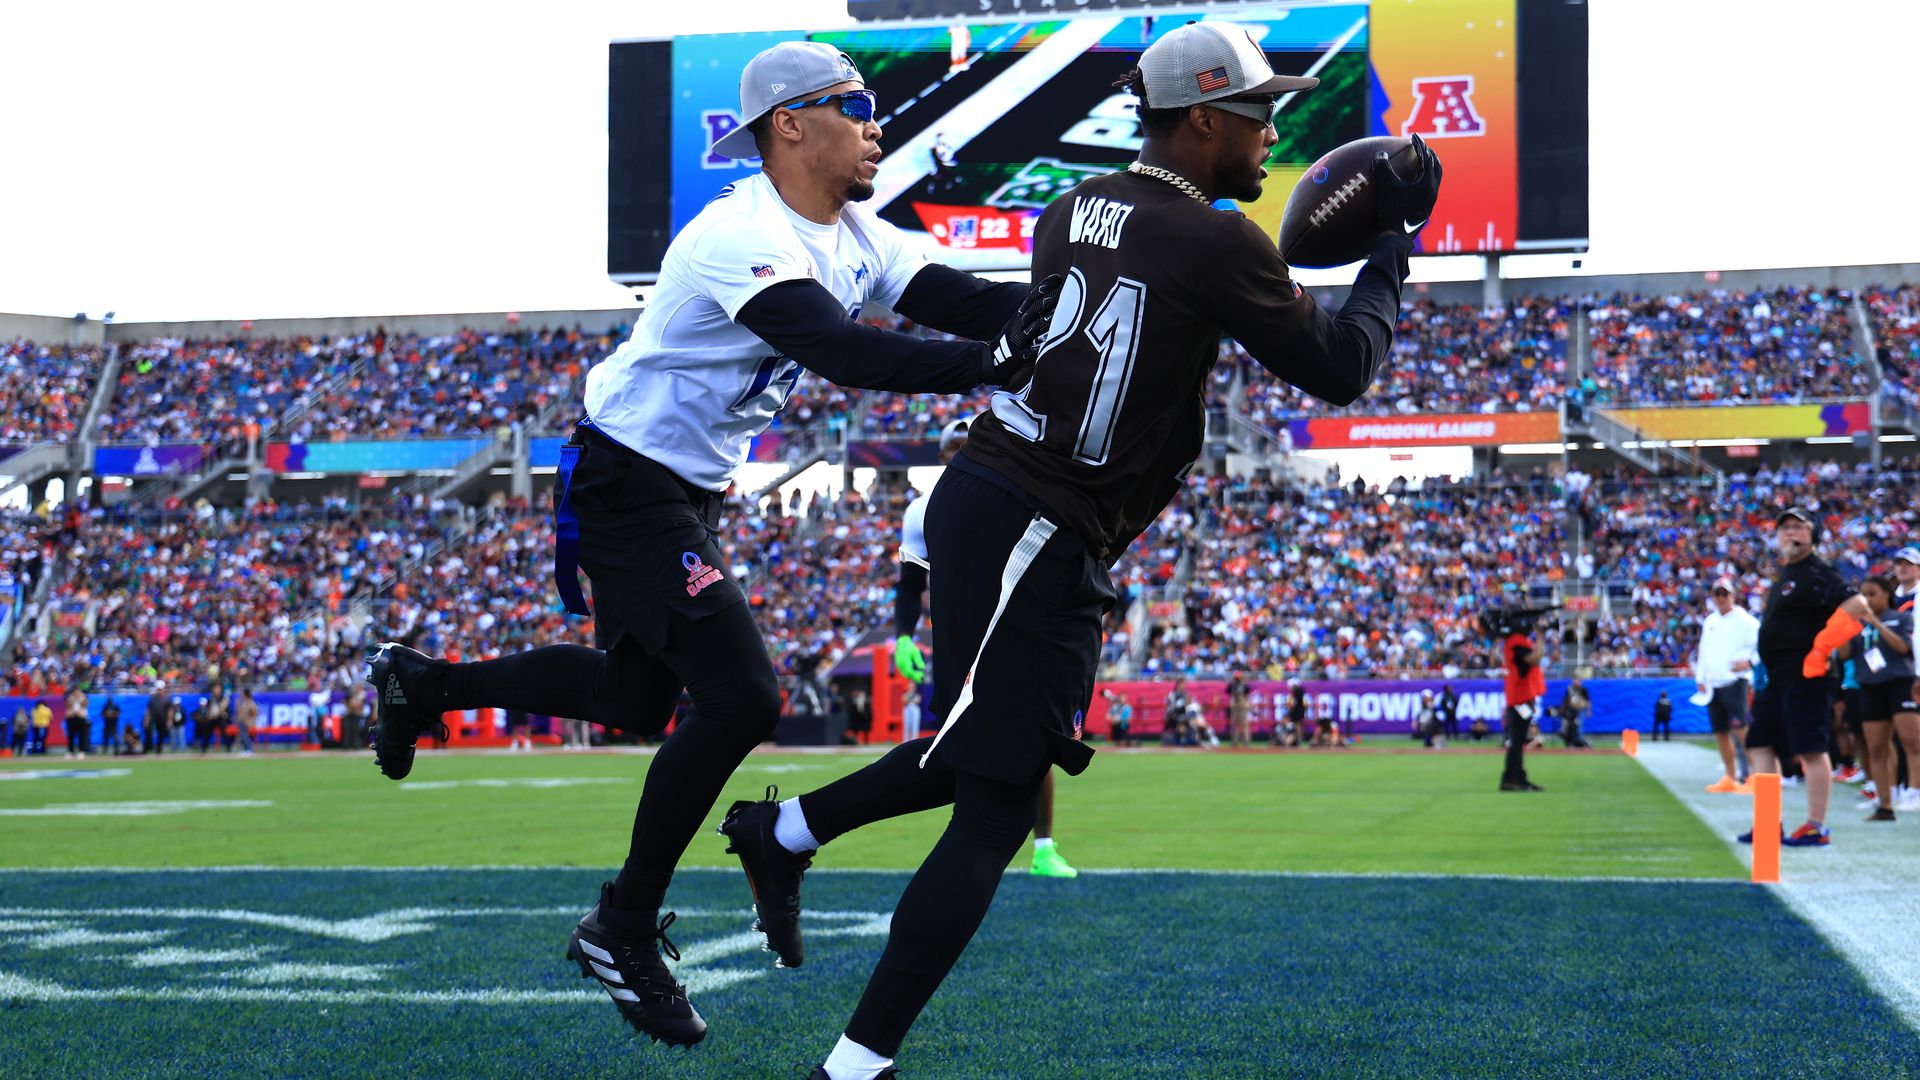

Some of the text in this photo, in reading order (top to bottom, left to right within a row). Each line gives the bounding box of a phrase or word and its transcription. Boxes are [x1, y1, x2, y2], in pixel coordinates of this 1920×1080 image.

[1401, 75, 1486, 139] A
[980, 217, 1010, 239] 22
[1069, 195, 1134, 249] WARD
[991, 266, 1147, 465] 21
[1349, 421, 1496, 440] #PROBOWLGAMES
